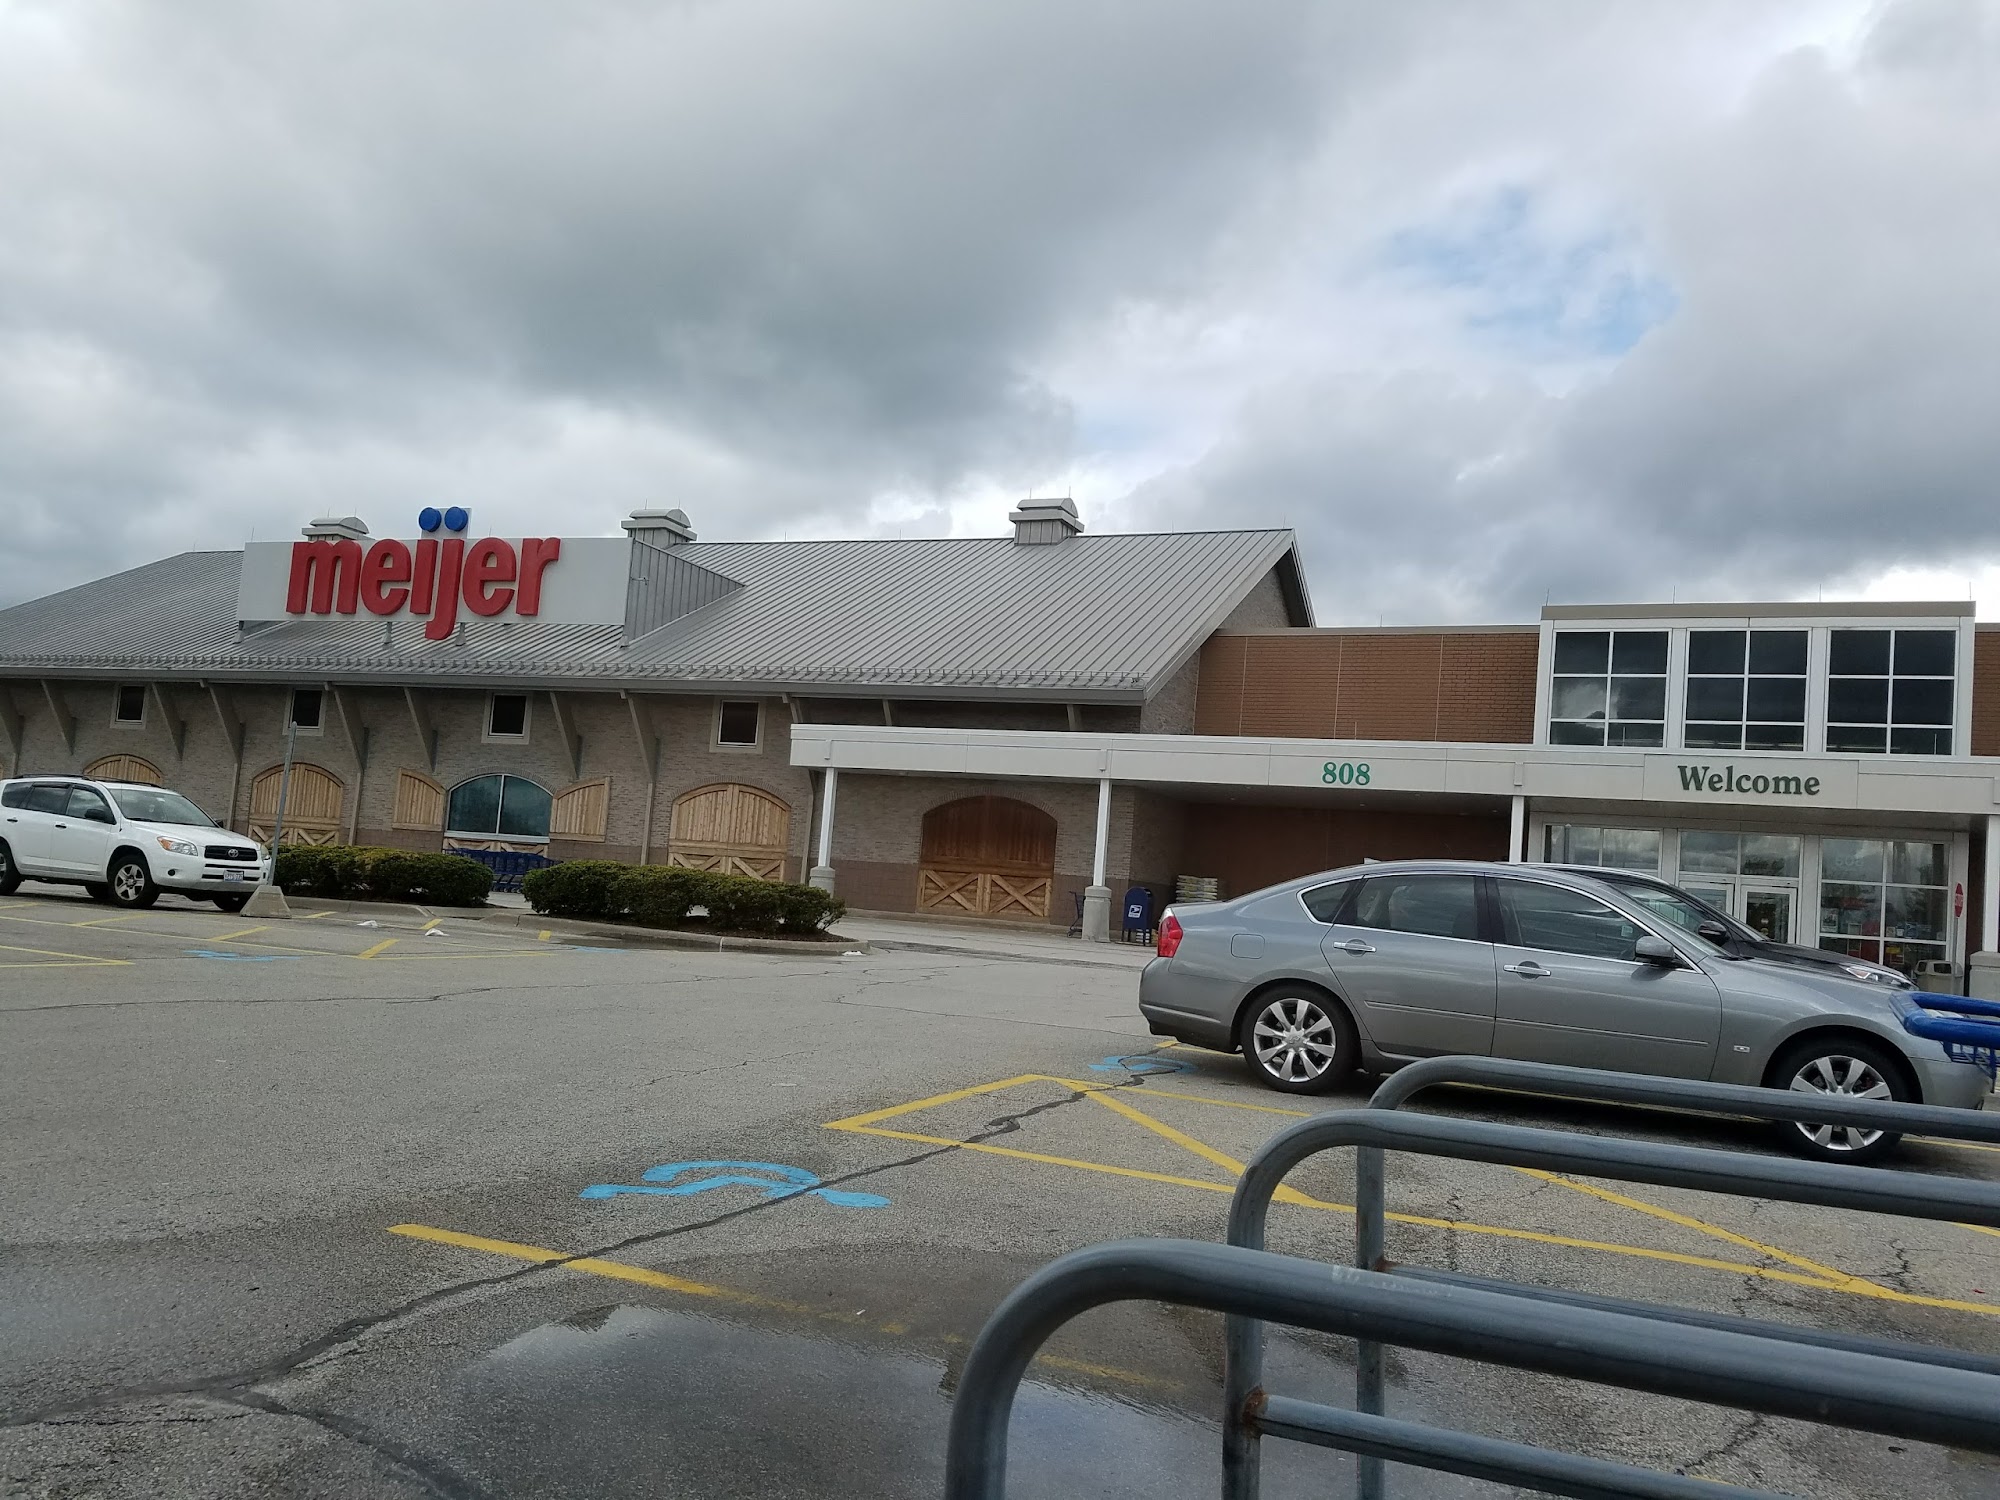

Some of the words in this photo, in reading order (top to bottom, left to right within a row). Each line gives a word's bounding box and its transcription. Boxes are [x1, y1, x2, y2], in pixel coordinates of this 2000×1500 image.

[286, 507, 561, 640] meijer
[1322, 762, 1370, 785] 808
[1677, 765, 1820, 795] Welcome
